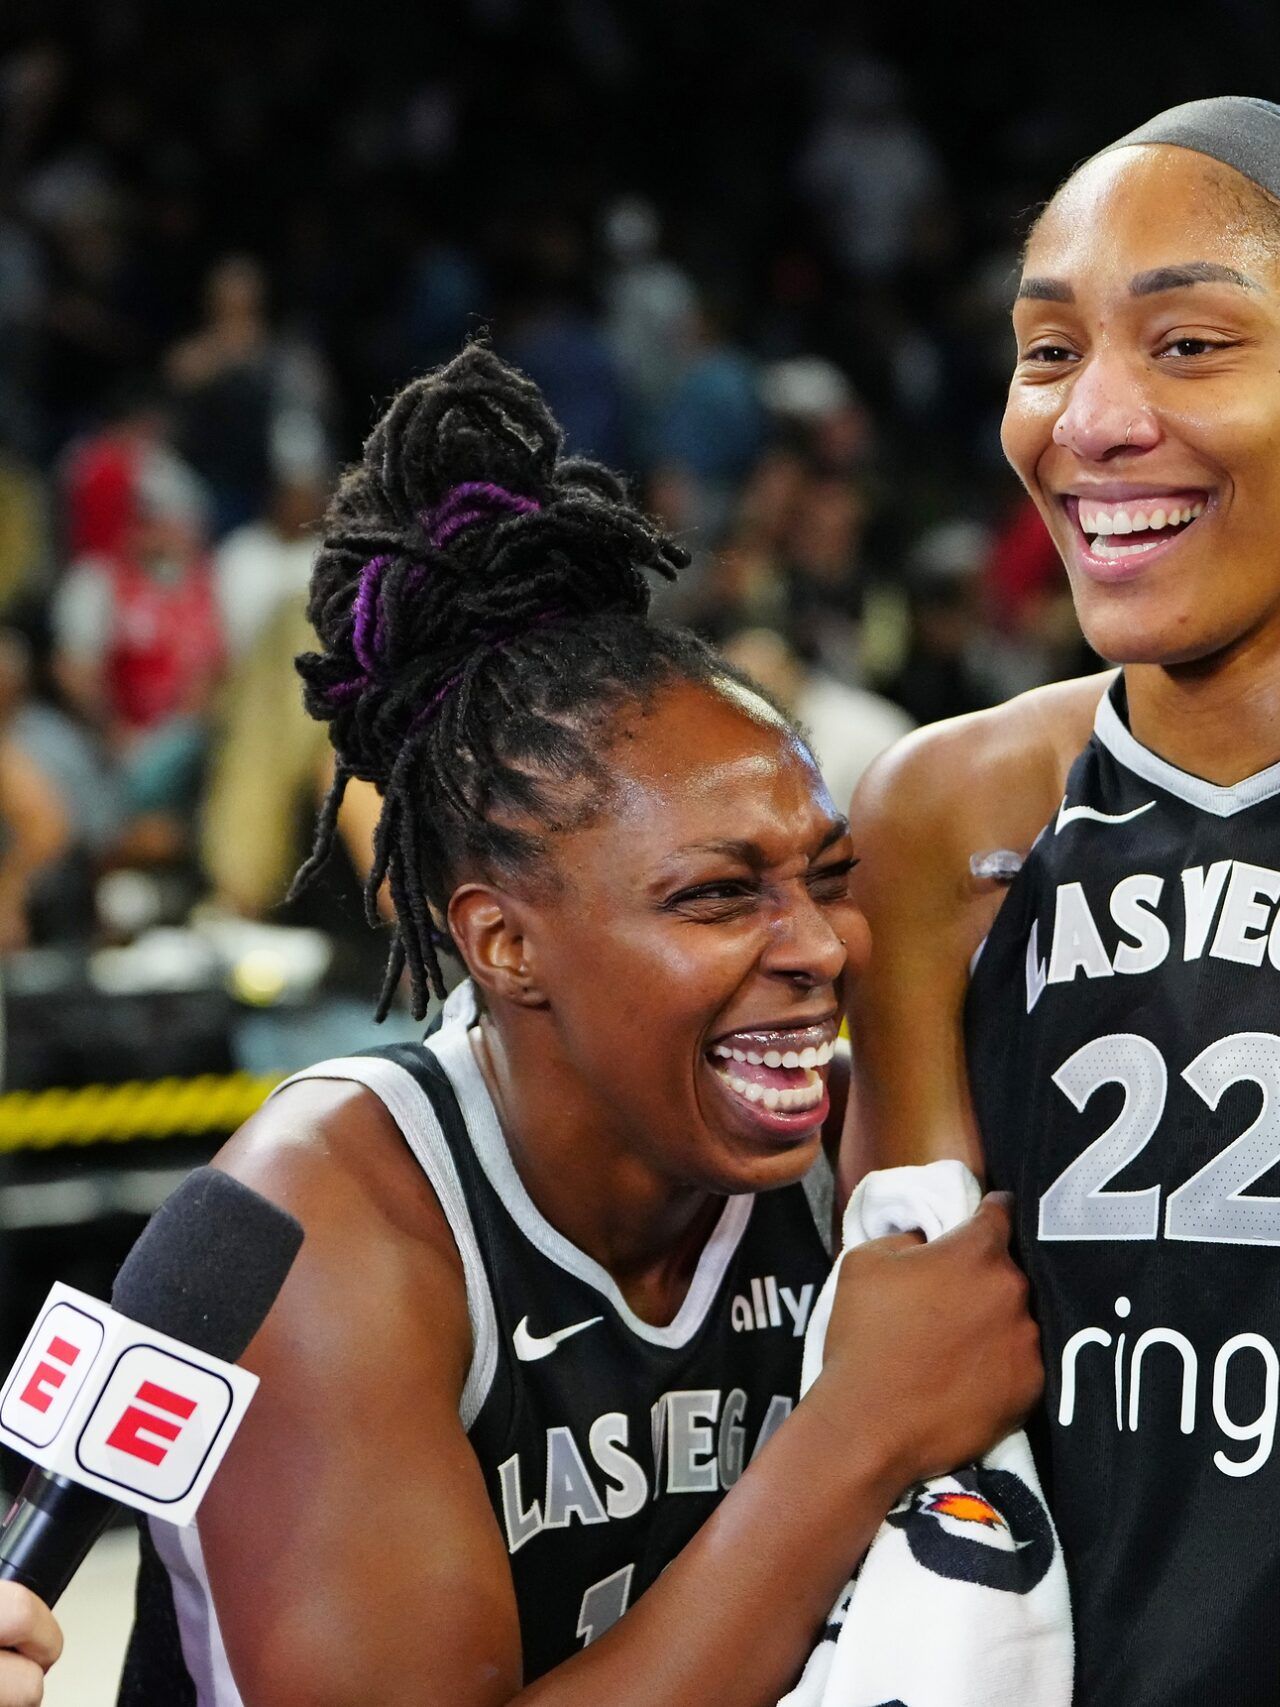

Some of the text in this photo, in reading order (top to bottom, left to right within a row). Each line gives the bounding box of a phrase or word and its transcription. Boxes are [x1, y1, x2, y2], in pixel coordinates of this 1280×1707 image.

[1025, 873, 1171, 1015] LAS
[730, 1274, 815, 1338] ally
[19, 1335, 81, 1414] E
[104, 1380, 199, 1467] E
[1058, 1295, 1280, 1479] ring
[498, 1411, 649, 1555] LAS
